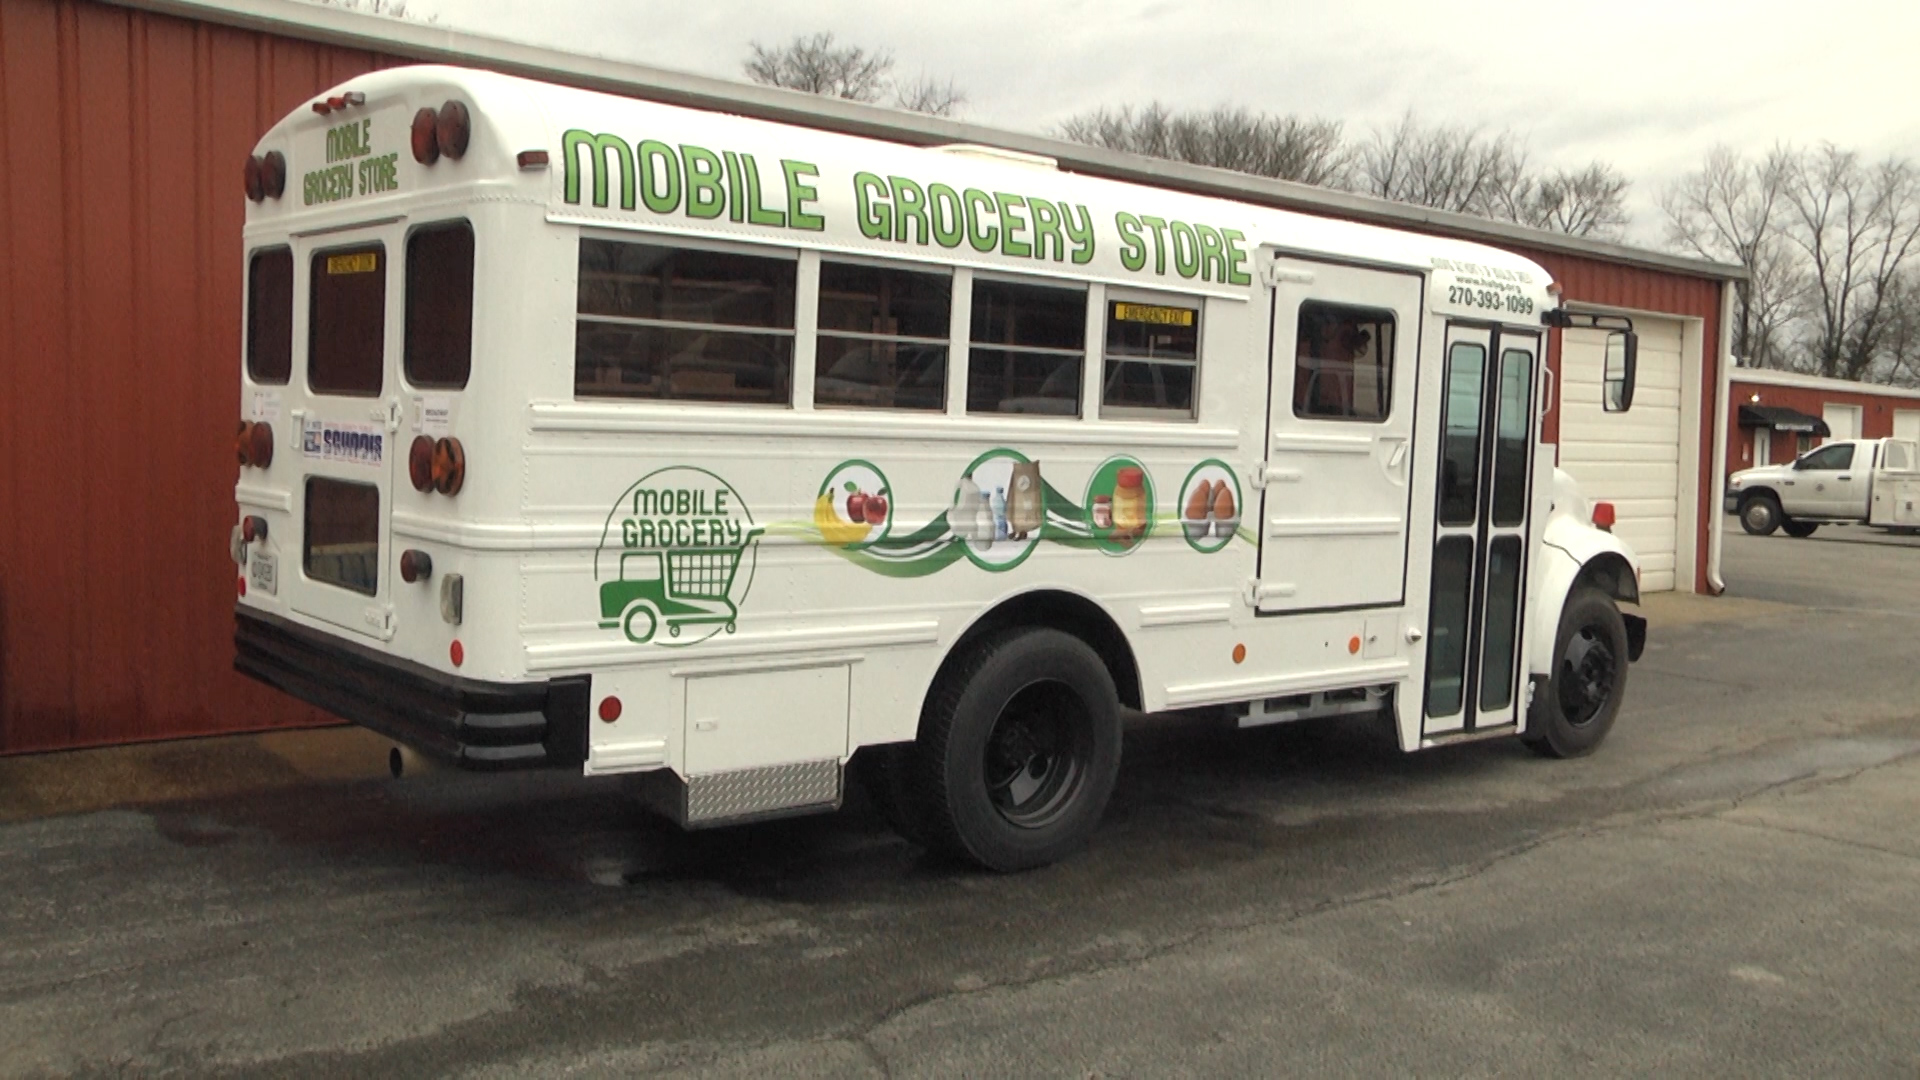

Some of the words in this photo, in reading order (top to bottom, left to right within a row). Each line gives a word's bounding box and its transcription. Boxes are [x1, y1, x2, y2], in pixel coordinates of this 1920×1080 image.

[326, 119, 371, 164] MOBILE
[303, 162, 354, 206] GROCERY
[358, 152, 398, 195] STORE
[561, 128, 825, 232] MOBILE
[853, 171, 1096, 264] GROCERY
[1115, 211, 1253, 286] STORE
[1448, 285, 1533, 315] 270-393-1099
[633, 489, 729, 516] MOBILE
[621, 518, 741, 548] GROCERY
